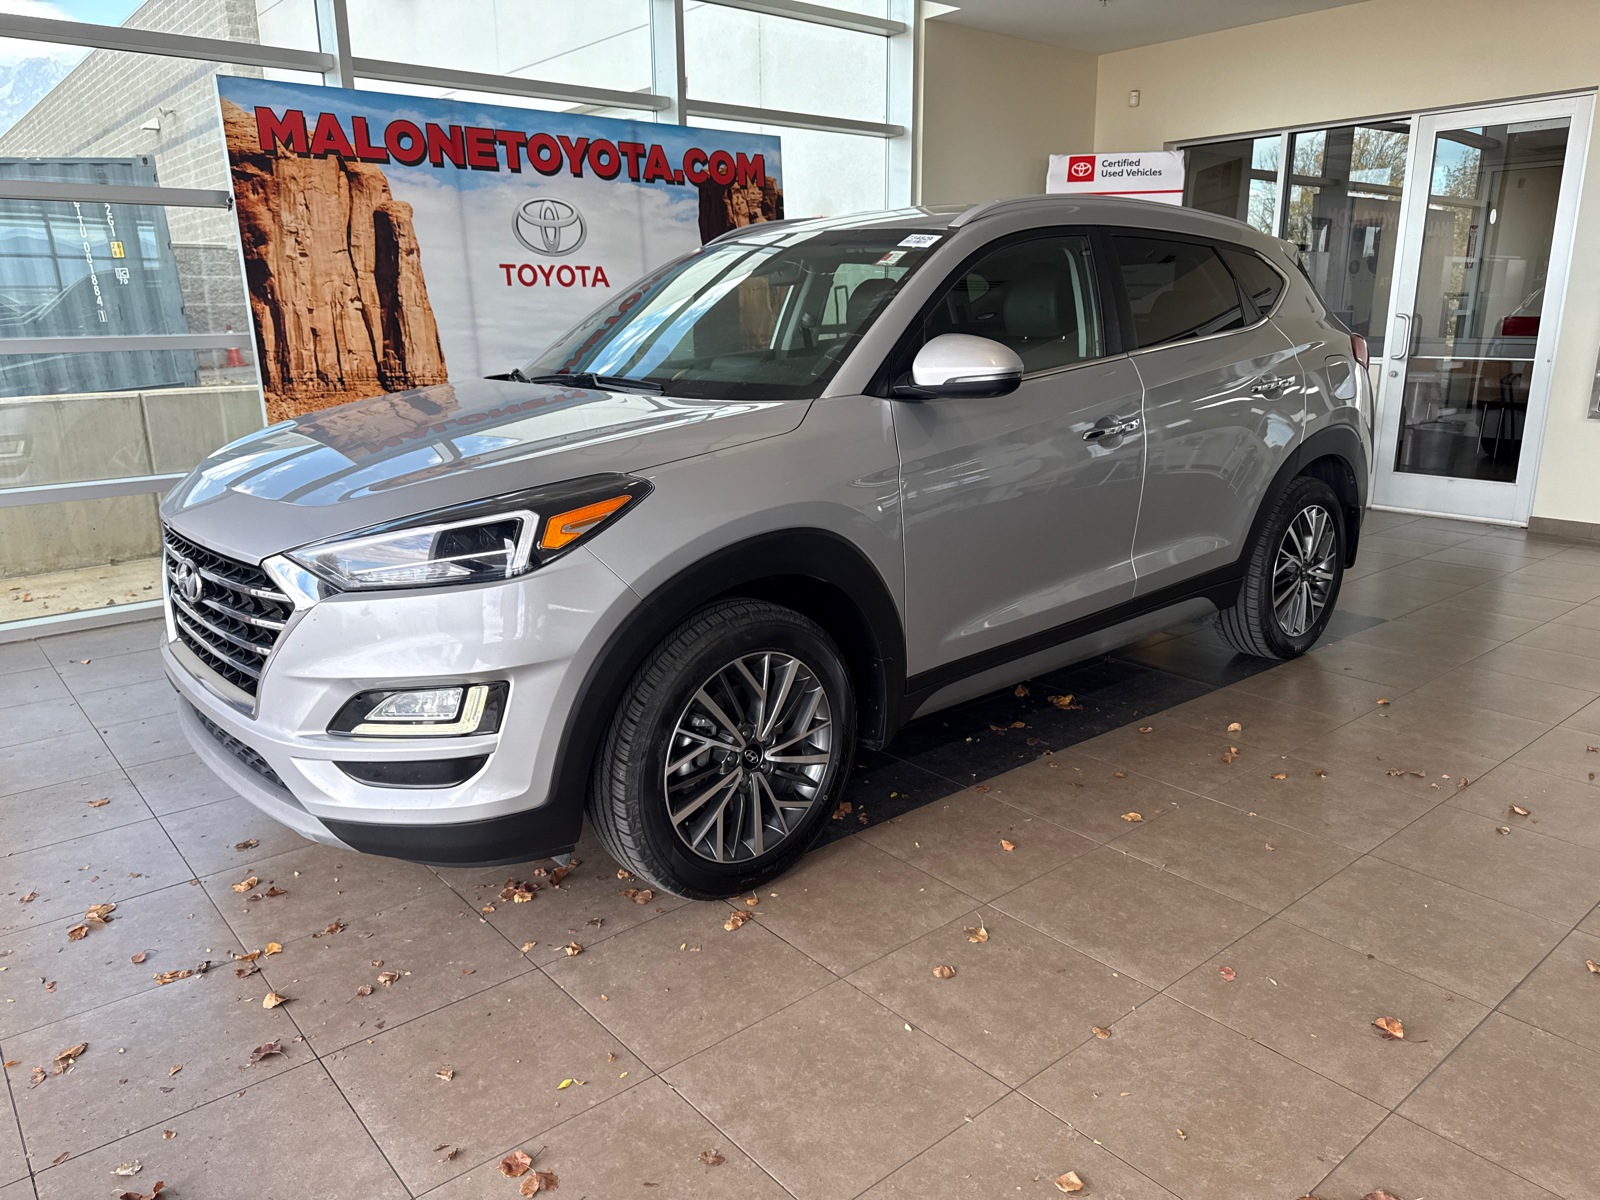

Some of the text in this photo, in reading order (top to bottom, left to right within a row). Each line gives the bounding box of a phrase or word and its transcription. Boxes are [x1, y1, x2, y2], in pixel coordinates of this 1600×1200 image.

[254, 105, 766, 189] MALONETOYOTA.COM
[1101, 158, 1141, 168] Certified
[1101, 168, 1162, 177] Used Vehicles
[74, 201, 87, 238] TTU
[104, 203, 116, 237] 2G1
[499, 263, 610, 288] TOYOTA
